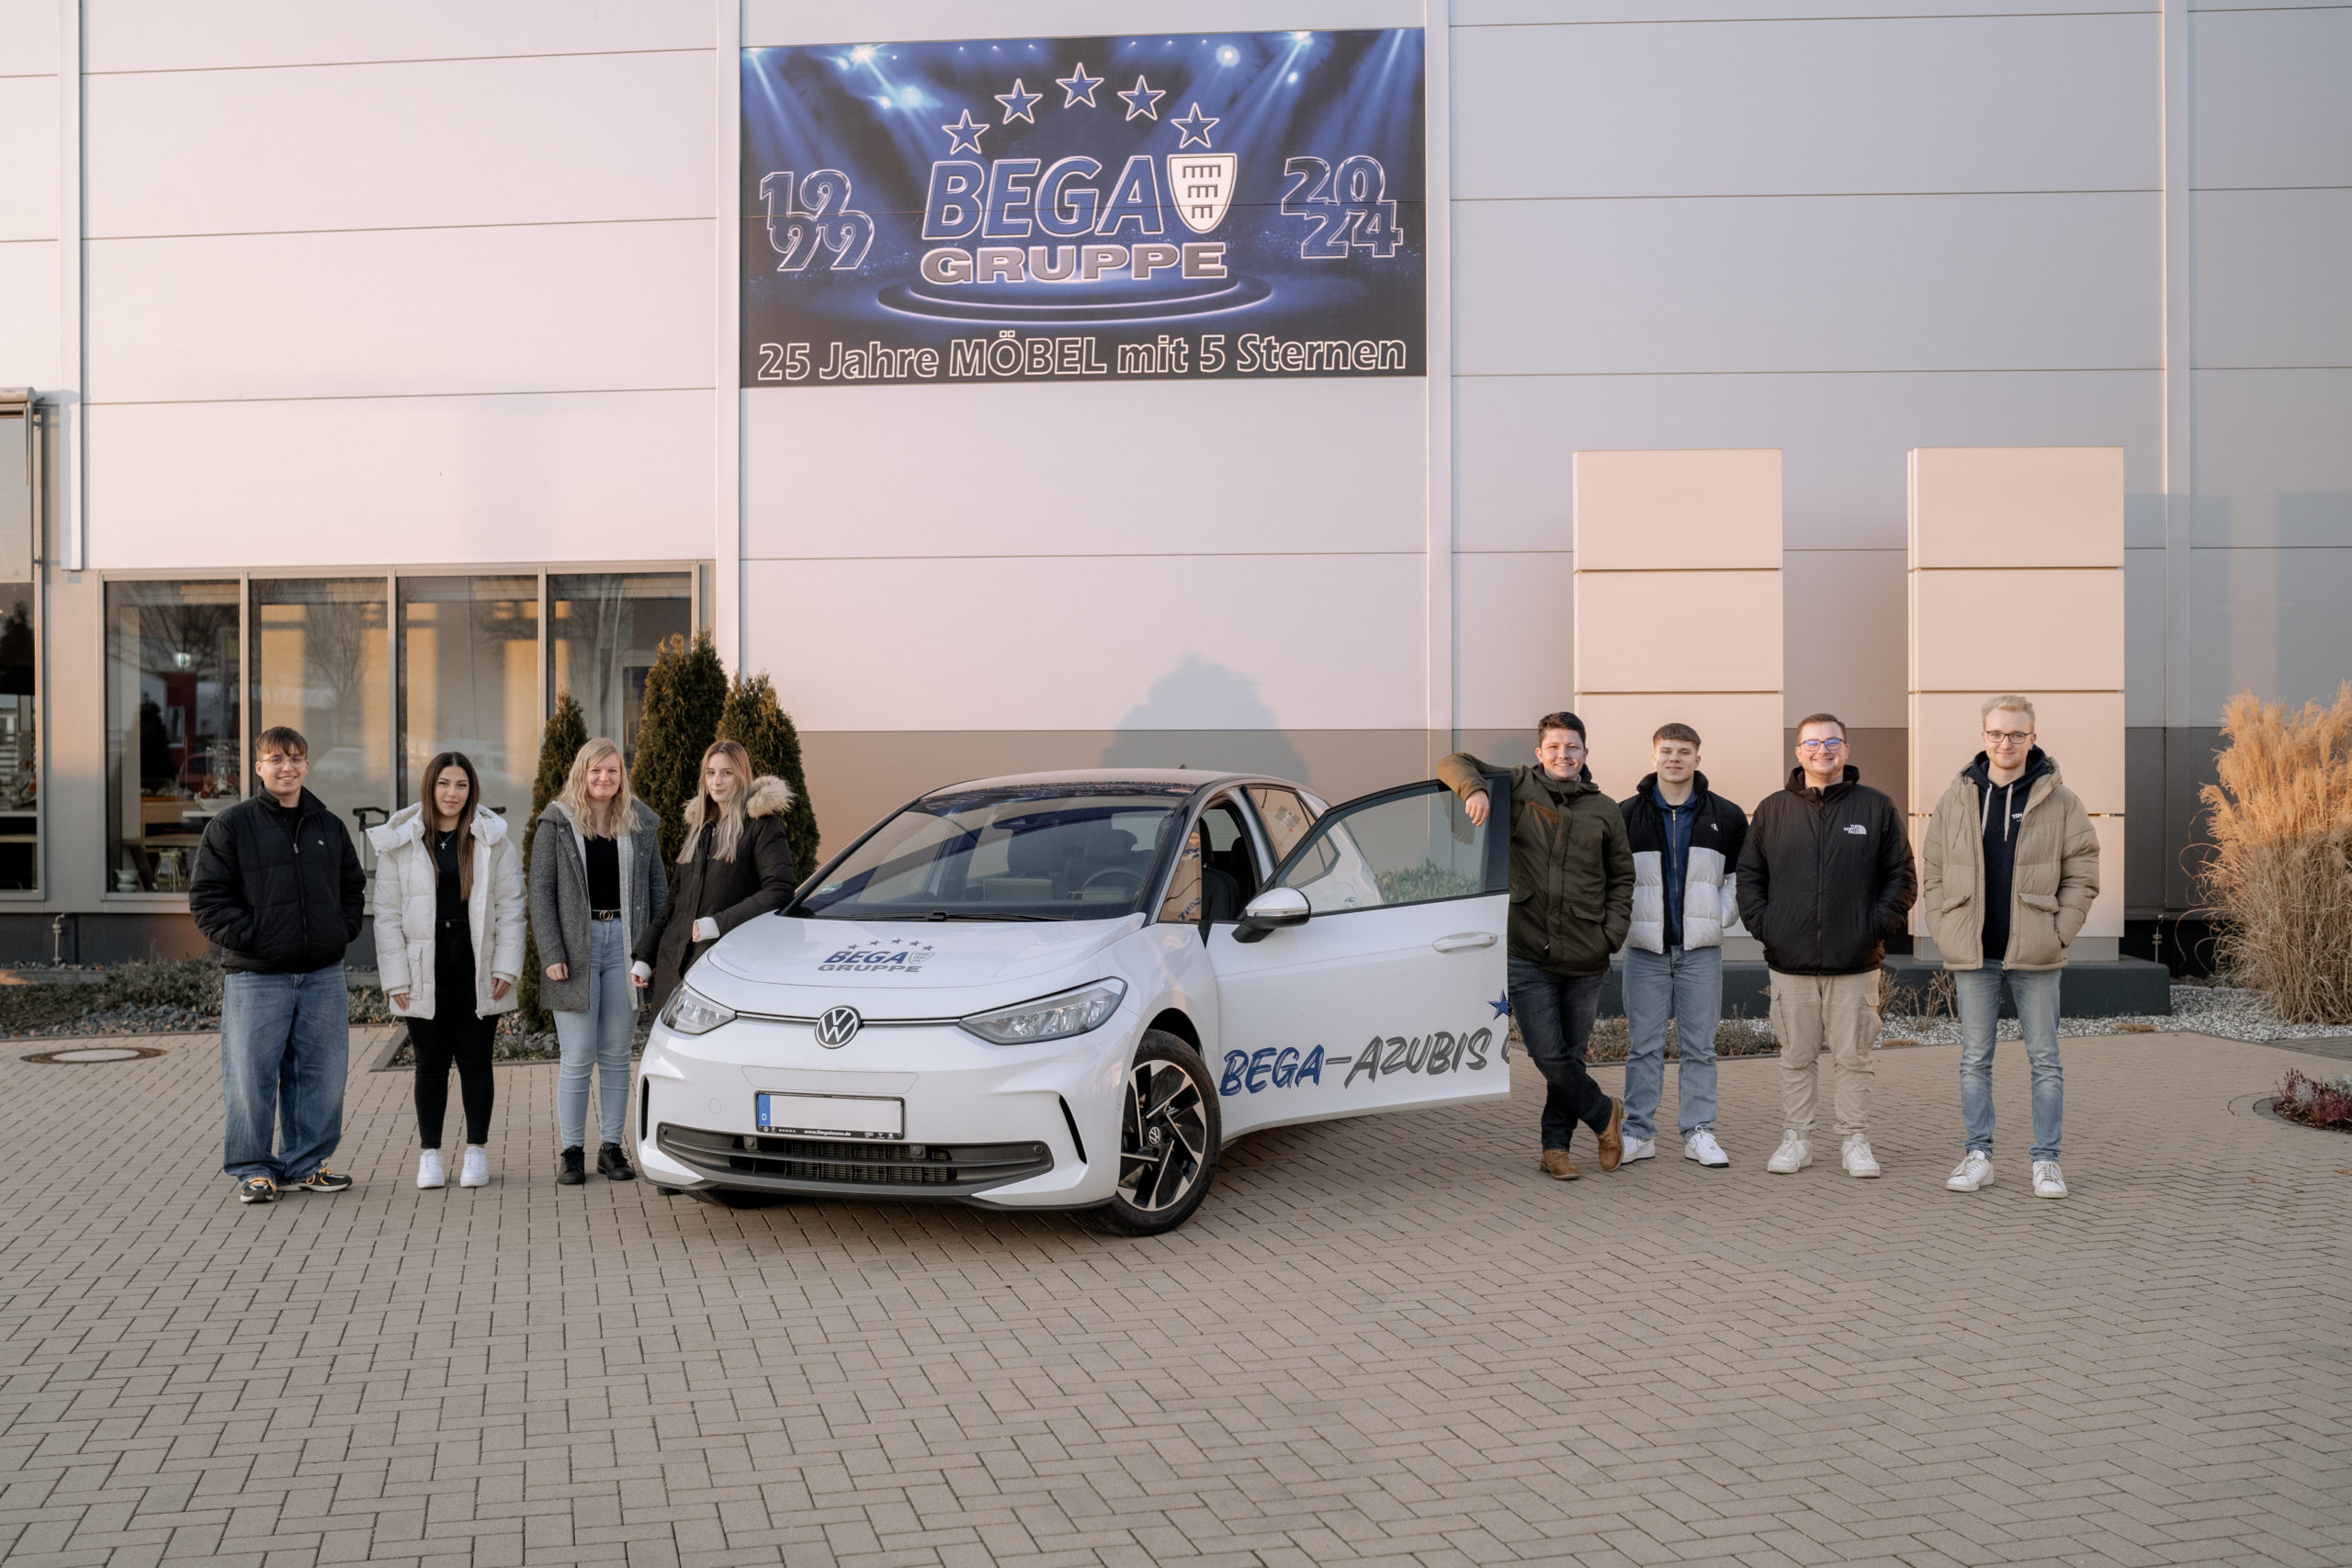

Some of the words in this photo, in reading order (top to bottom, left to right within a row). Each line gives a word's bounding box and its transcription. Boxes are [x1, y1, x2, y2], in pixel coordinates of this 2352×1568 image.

[922, 154, 1165, 240] BEGA
[921, 243, 1228, 286] GRUPPE
[757, 343, 811, 380] 25
[820, 341, 940, 379] Jahre
[949, 330, 1108, 378] MÖBEL
[1117, 334, 1189, 374] mit
[1200, 333, 1227, 372] 5
[1237, 333, 1407, 372] Sternen
[818, 964, 922, 973] GRUPPE
[823, 951, 909, 964] BEGA
[1219, 1027, 1493, 1097] BEGA-AZUBIS
[762, 1112, 767, 1122] D
